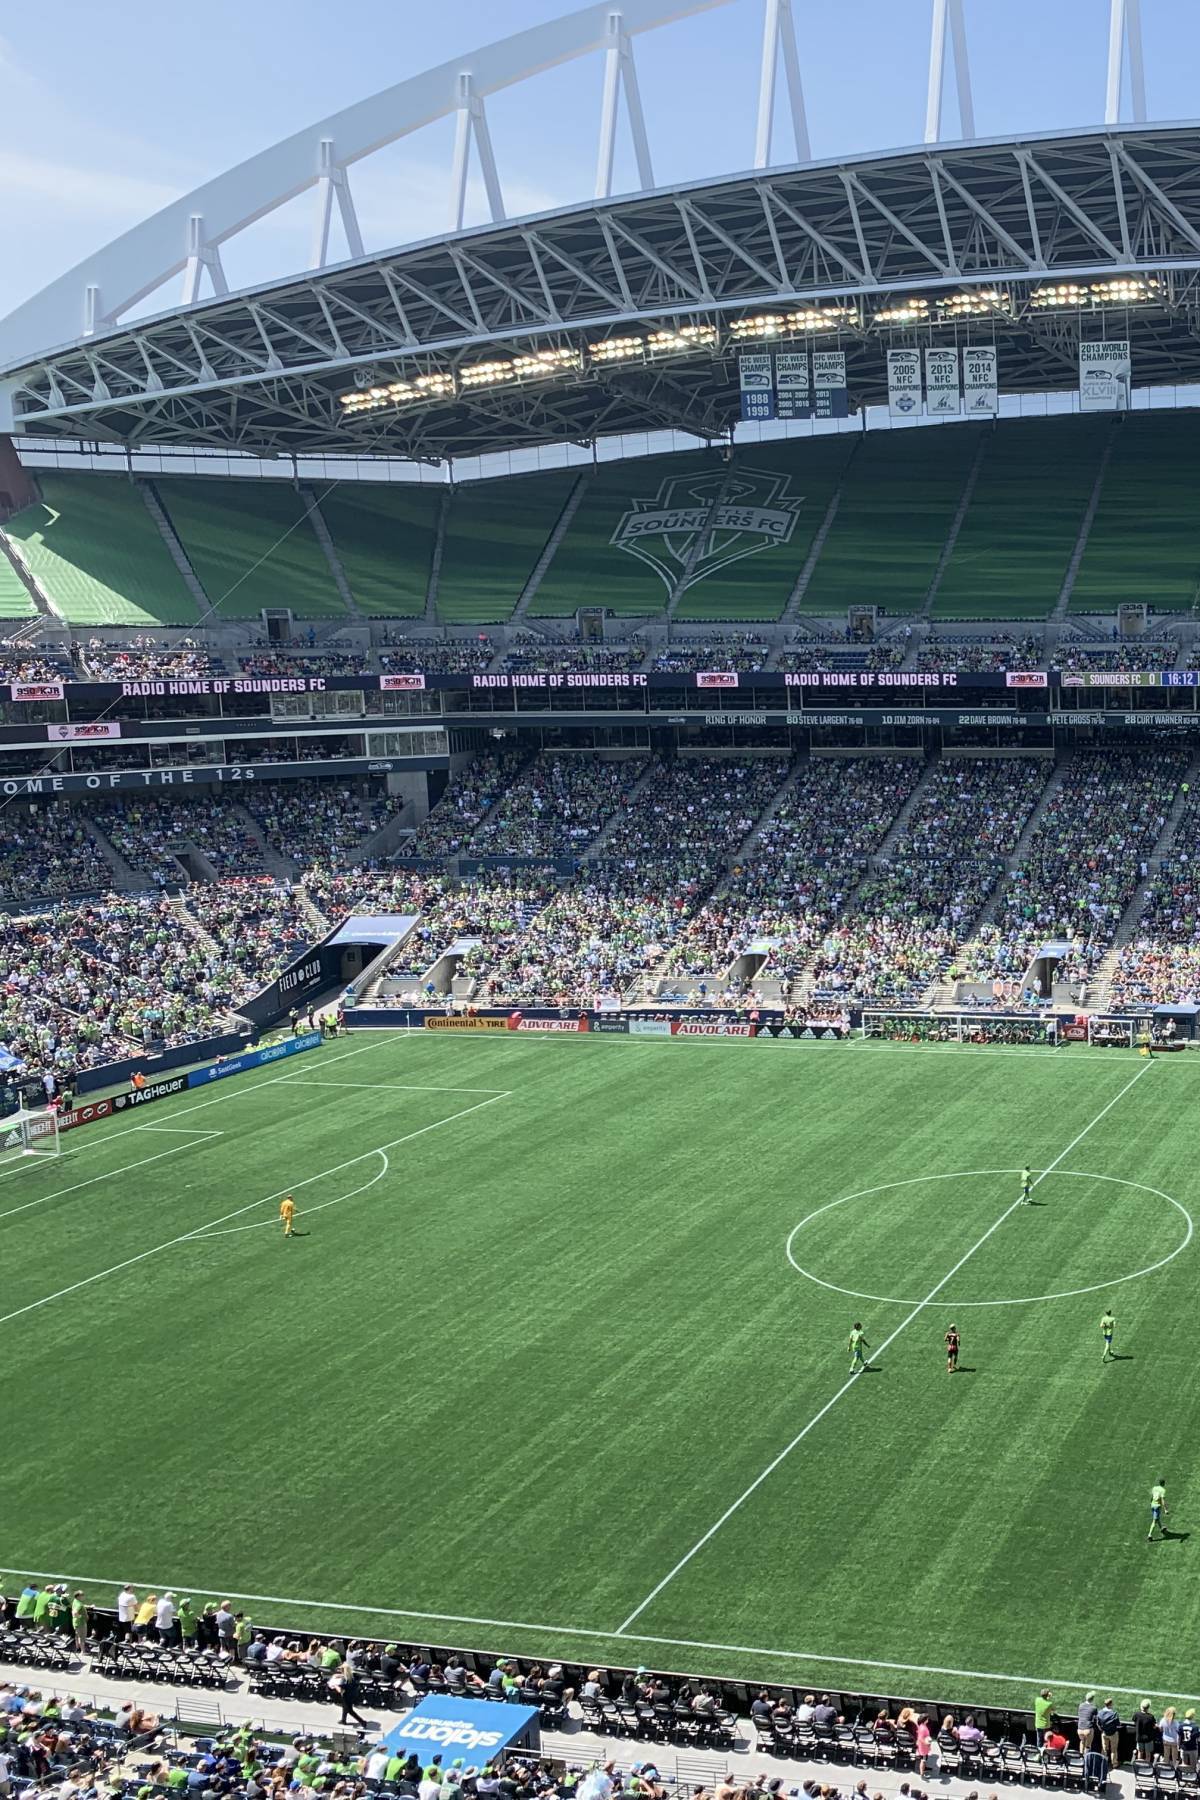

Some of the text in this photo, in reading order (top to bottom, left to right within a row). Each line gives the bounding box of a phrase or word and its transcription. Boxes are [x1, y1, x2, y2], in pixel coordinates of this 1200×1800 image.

[1082, 343, 1127, 352] 2013 WORLD
[1082, 352, 1127, 362] CHAMPIONS
[741, 364, 770, 373] CHAMPS
[778, 363, 807, 371] CHAMPS
[815, 361, 844, 370] CHAMPS
[893, 365, 915, 375] 2005
[931, 365, 953, 374] 2013
[969, 363, 991, 373] 2014
[897, 375, 912, 383] NFC
[935, 375, 950, 383] NFC
[972, 374, 988, 382] NFC
[746, 394, 768, 404] 1988
[747, 406, 769, 416] 1999
[758, 519, 785, 532] FC
[474, 674, 647, 687] RADIO HOME OF SOUNDERS FC
[785, 674, 957, 685] RADIO HOME OF SOUNDERS FC
[1090, 674, 1128, 685] SOUNDERS
[1131, 674, 1141, 685] FC
[1149, 674, 1155, 684] 0
[1168, 674, 1193, 684] 16:12
[123, 678, 325, 696] RADIO HOME OF SOUNDERS FC
[706, 716, 766, 724] RING OF HONOR
[799, 716, 818, 724] STEVE
[820, 716, 847, 724] LARGENT
[893, 716, 905, 724] JIM
[906, 716, 924, 724] ZORN
[970, 716, 986, 724] DAVE
[988, 716, 1011, 724] BROWN
[1052, 716, 1068, 724] PETE
[1069, 716, 1091, 724] GROSS
[1137, 716, 1154, 724] CURT
[1155, 716, 1182, 724] WARNER
[4, 768, 254, 795] OME OF THE 12s
[279, 972, 298, 993] FIELD
[306, 960, 320, 981] CLUB
[427, 1017, 505, 1029] Continental TIRE
[518, 1019, 579, 1031] ADVOCARE
[678, 1023, 750, 1036] ADVOCARE
[399, 1723, 503, 1749] slalom
